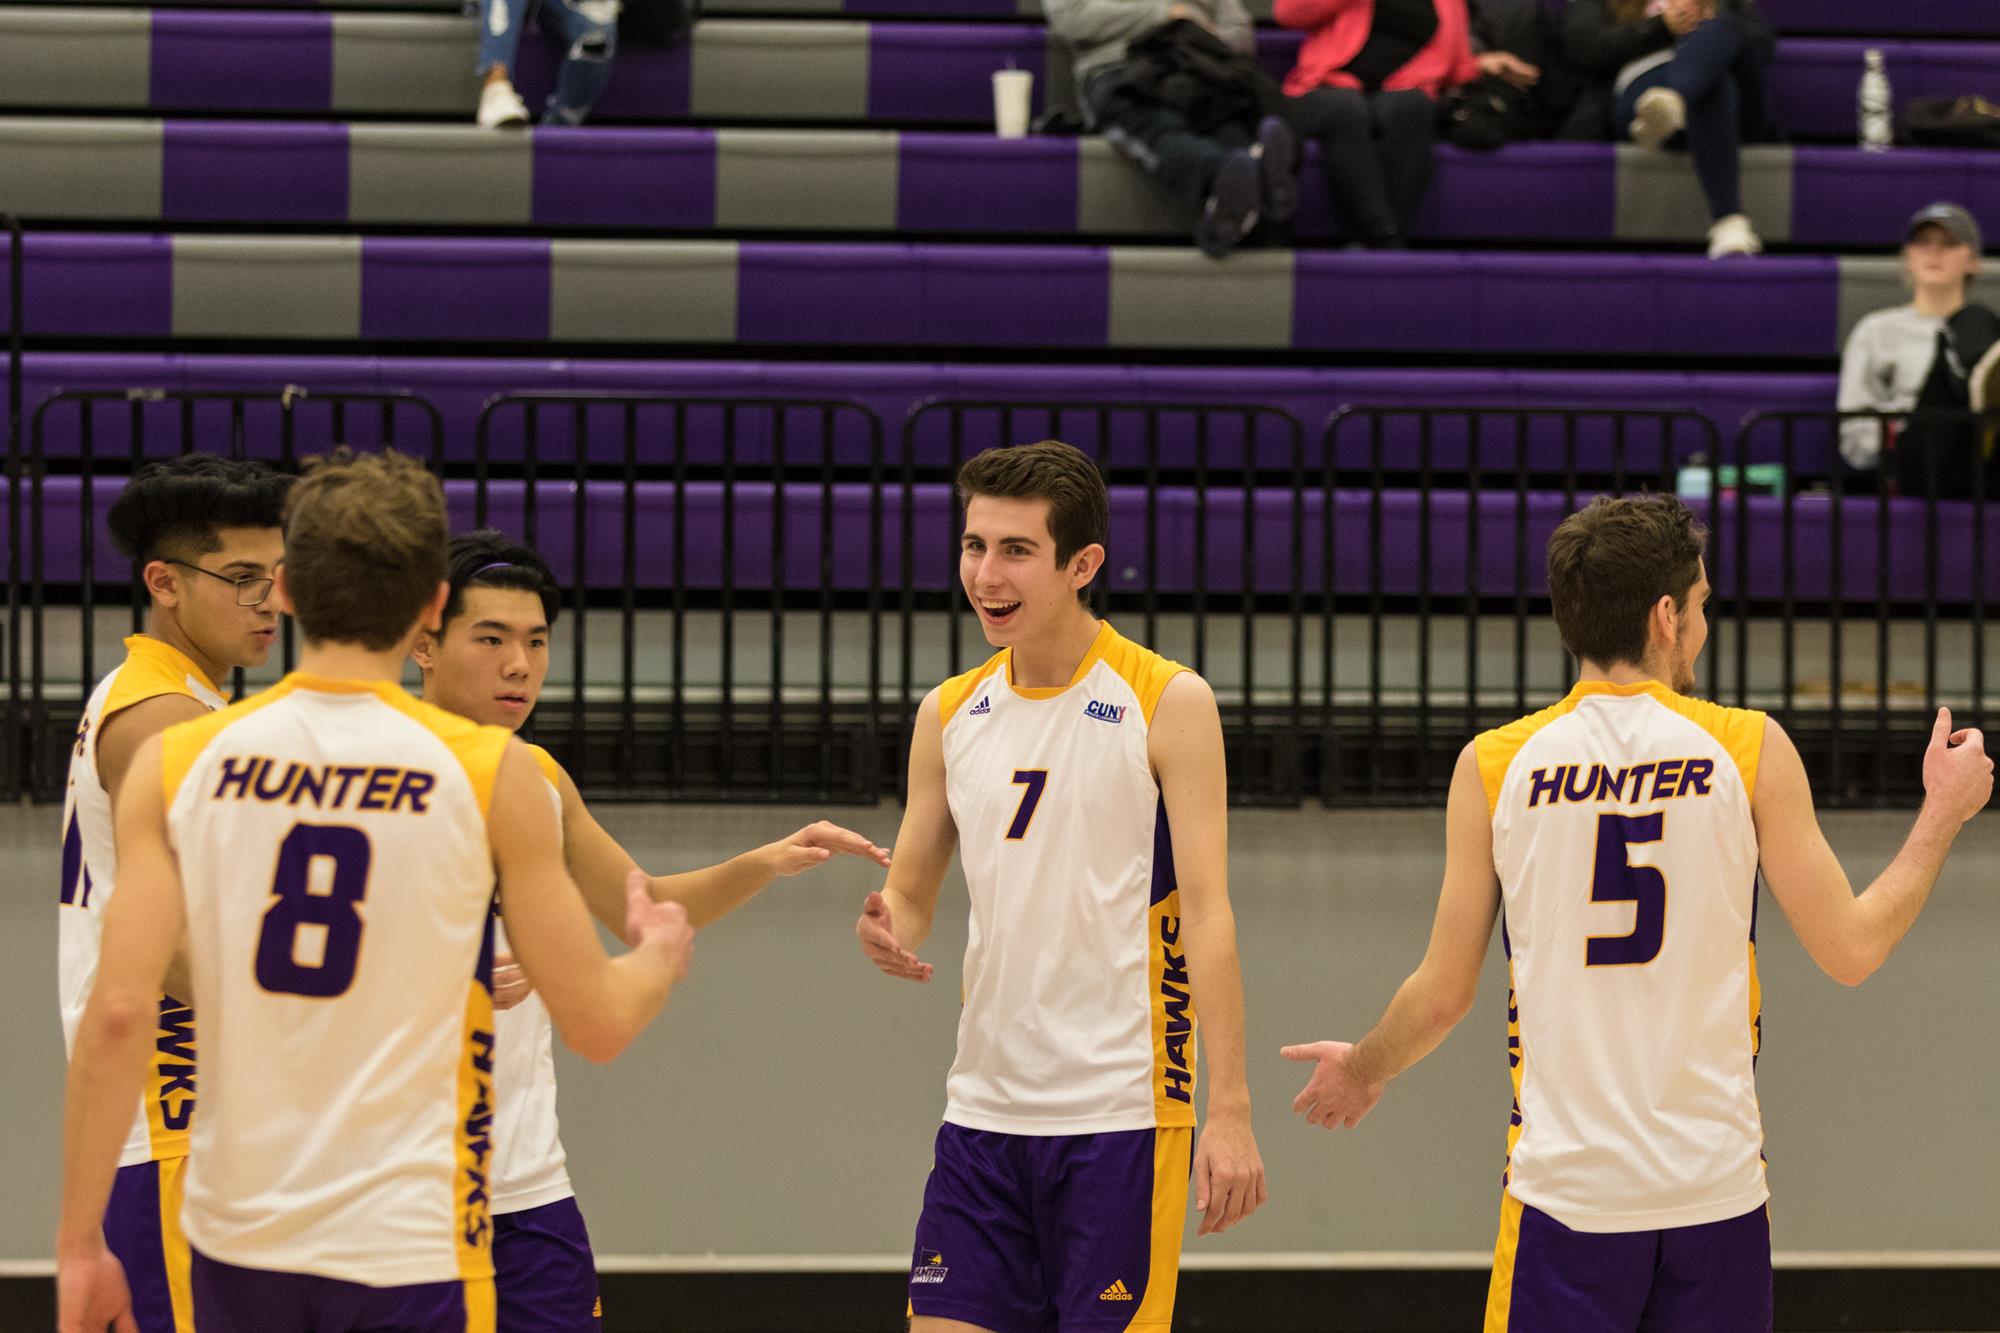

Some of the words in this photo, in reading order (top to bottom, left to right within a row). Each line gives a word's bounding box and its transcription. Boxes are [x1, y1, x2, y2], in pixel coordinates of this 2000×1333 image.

[1087, 699, 1127, 720] CUNY
[213, 756, 436, 815] HUNTER
[1003, 768, 1050, 841] 7
[1527, 757, 1715, 809] HUNTER
[253, 820, 374, 998] 8
[1584, 810, 1667, 968] 5
[1099, 1291, 1133, 1301] adidas
